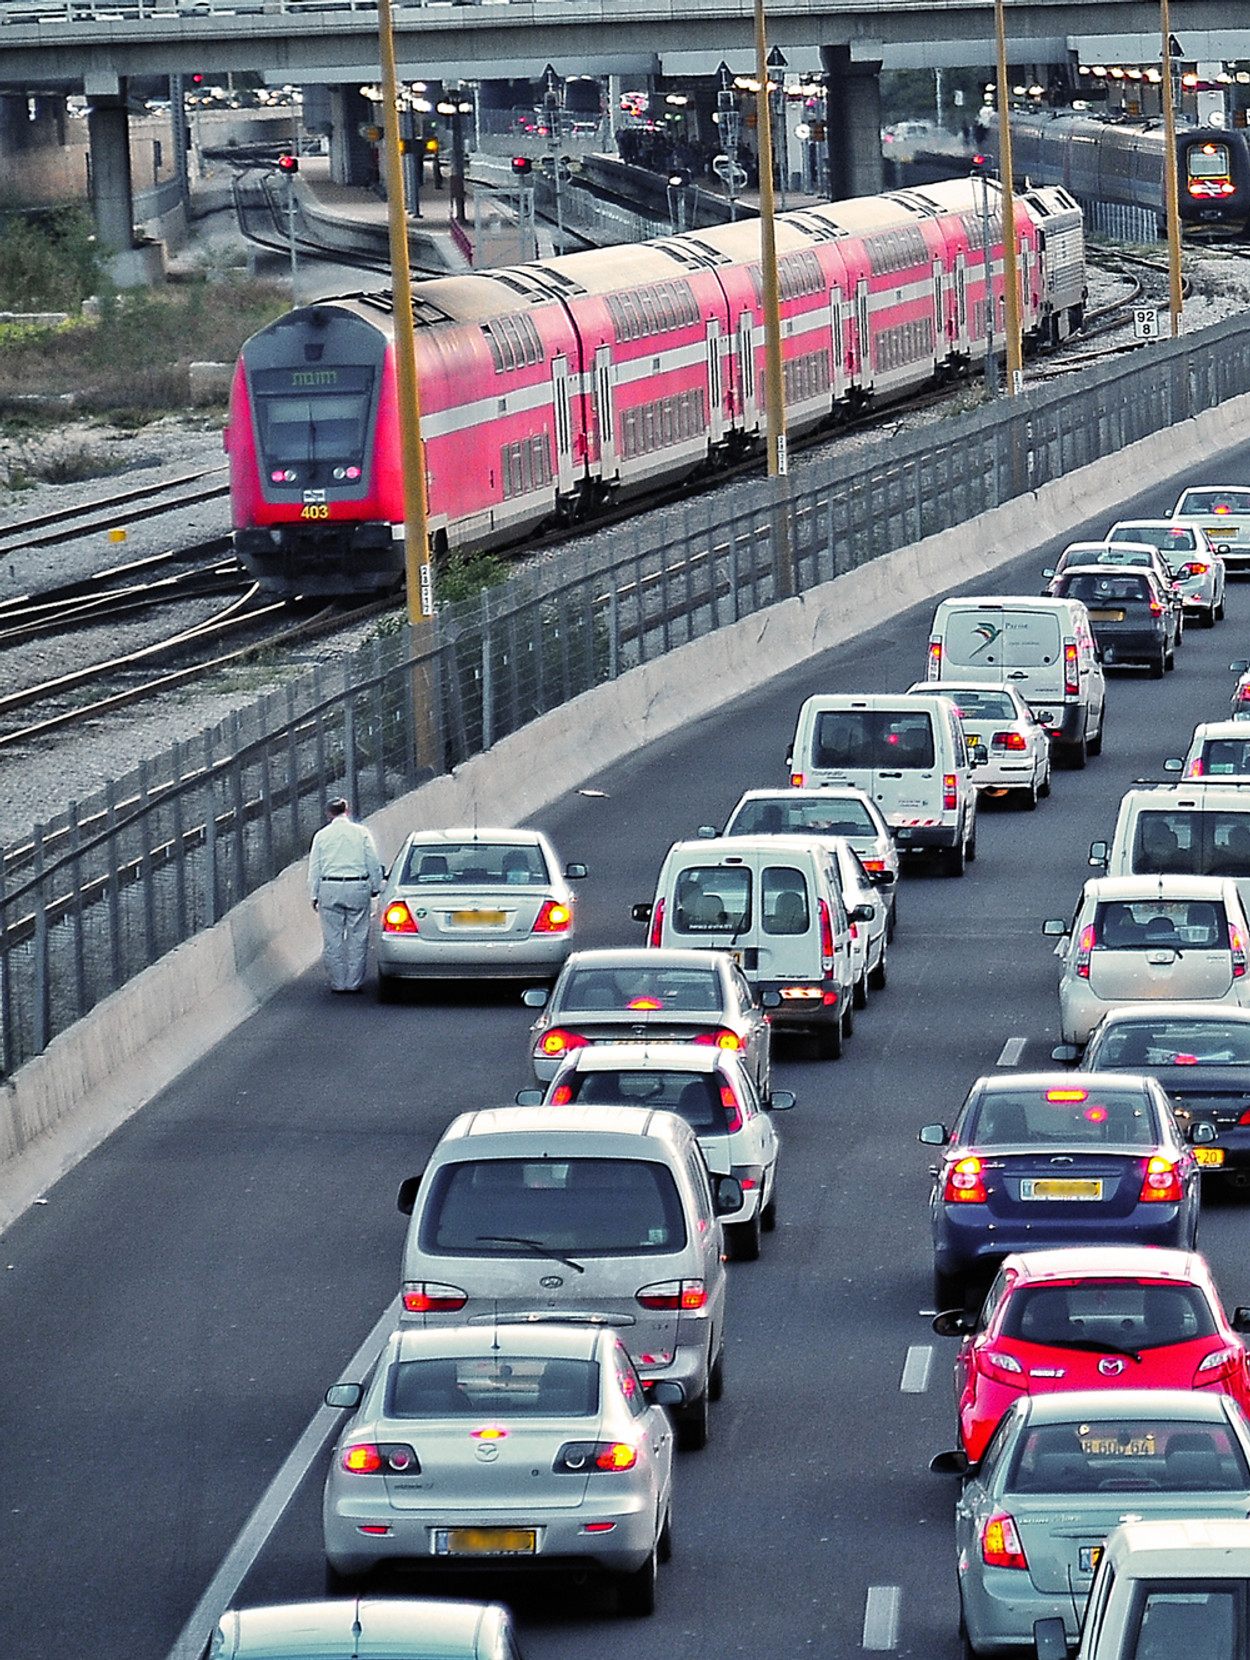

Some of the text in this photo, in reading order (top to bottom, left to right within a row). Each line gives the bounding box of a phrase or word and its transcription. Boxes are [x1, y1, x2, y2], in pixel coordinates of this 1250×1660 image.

[1137, 311, 1155, 323] 92
[1142, 323, 1151, 335] 8
[301, 505, 329, 519] 403
